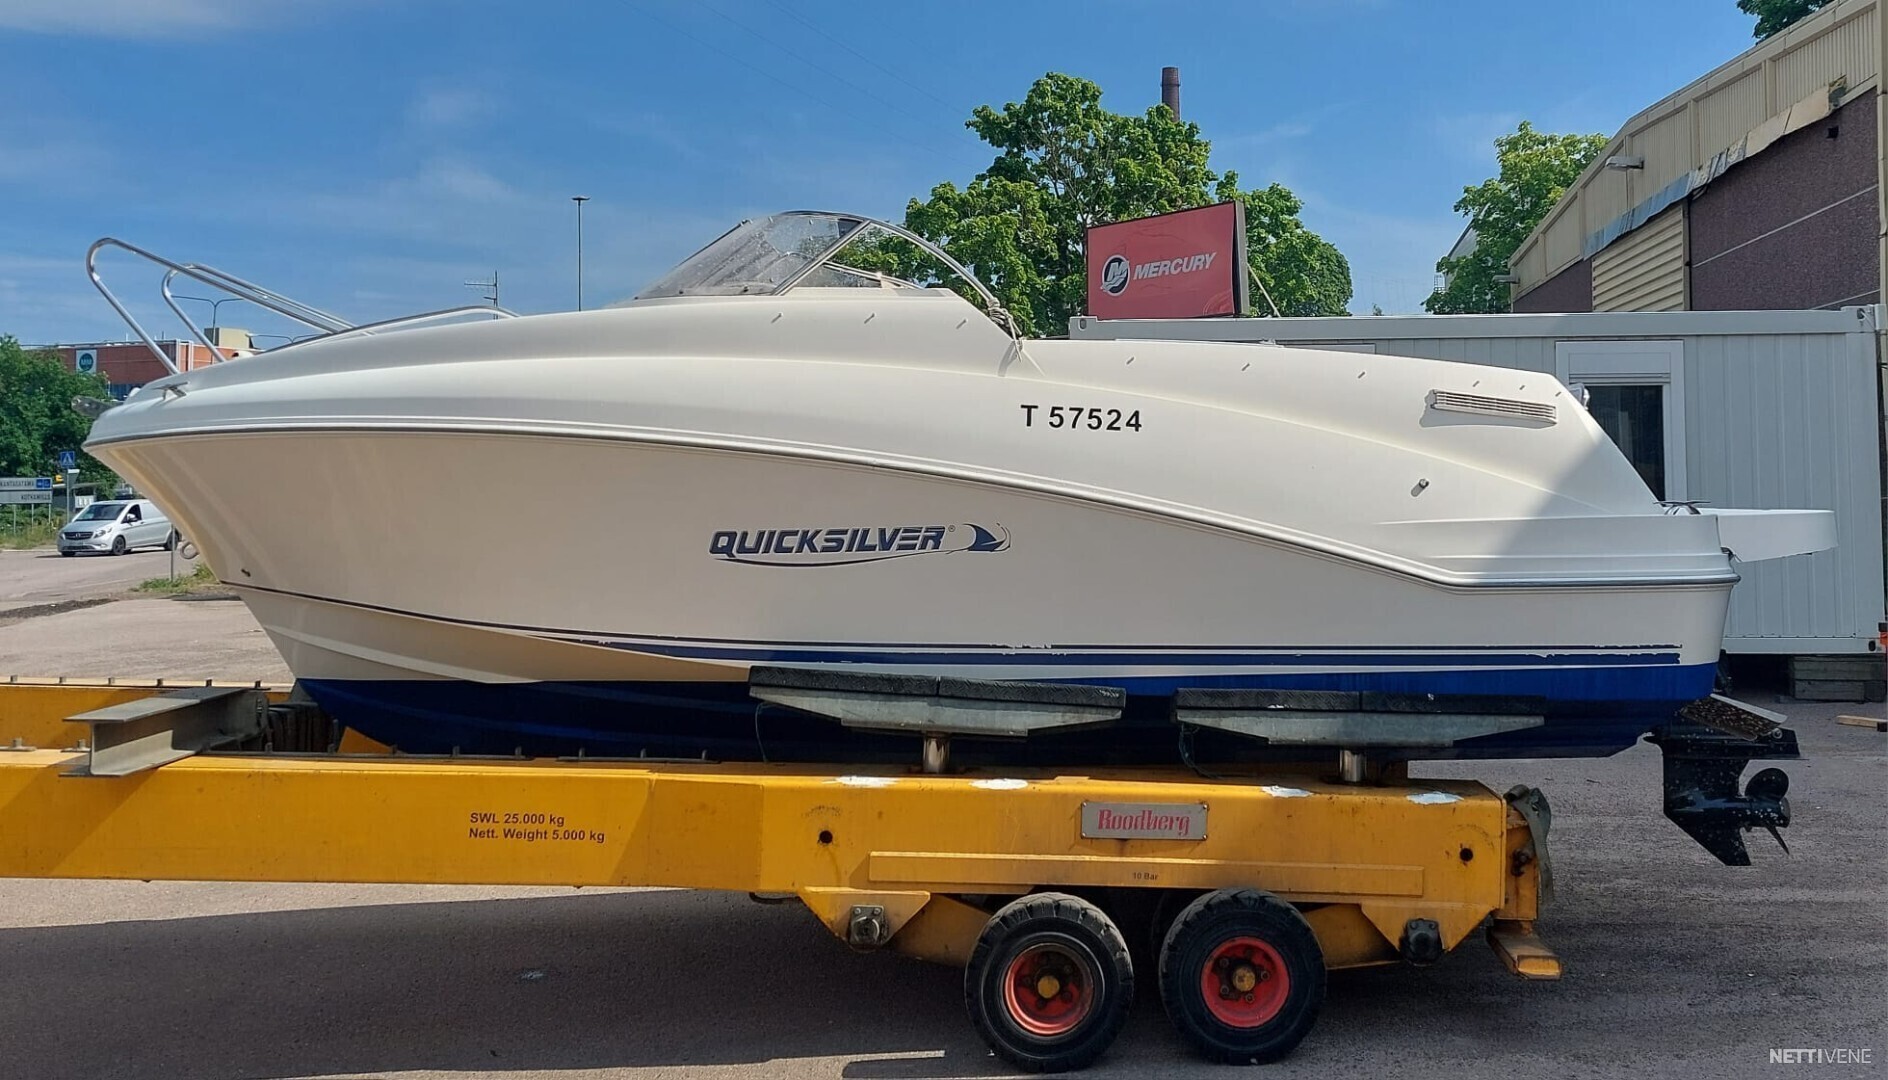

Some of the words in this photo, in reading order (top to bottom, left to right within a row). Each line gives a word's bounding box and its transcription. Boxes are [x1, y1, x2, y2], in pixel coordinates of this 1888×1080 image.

[1133, 252, 1217, 280] MERCURY
[1020, 404, 1039, 427] T
[1048, 406, 1142, 432] 57524
[709, 526, 946, 558] QUICKSILVER
[470, 812, 500, 824] SWL
[504, 813, 545, 825] 25.000
[549, 814, 565, 827] kg
[1098, 809, 1190, 836] Roodberg
[469, 827, 499, 839] Nett.
[503, 828, 548, 842] Weight
[552, 830, 586, 841] 5.000
[589, 831, 605, 843] kg
[1144, 873, 1159, 881] Bar
